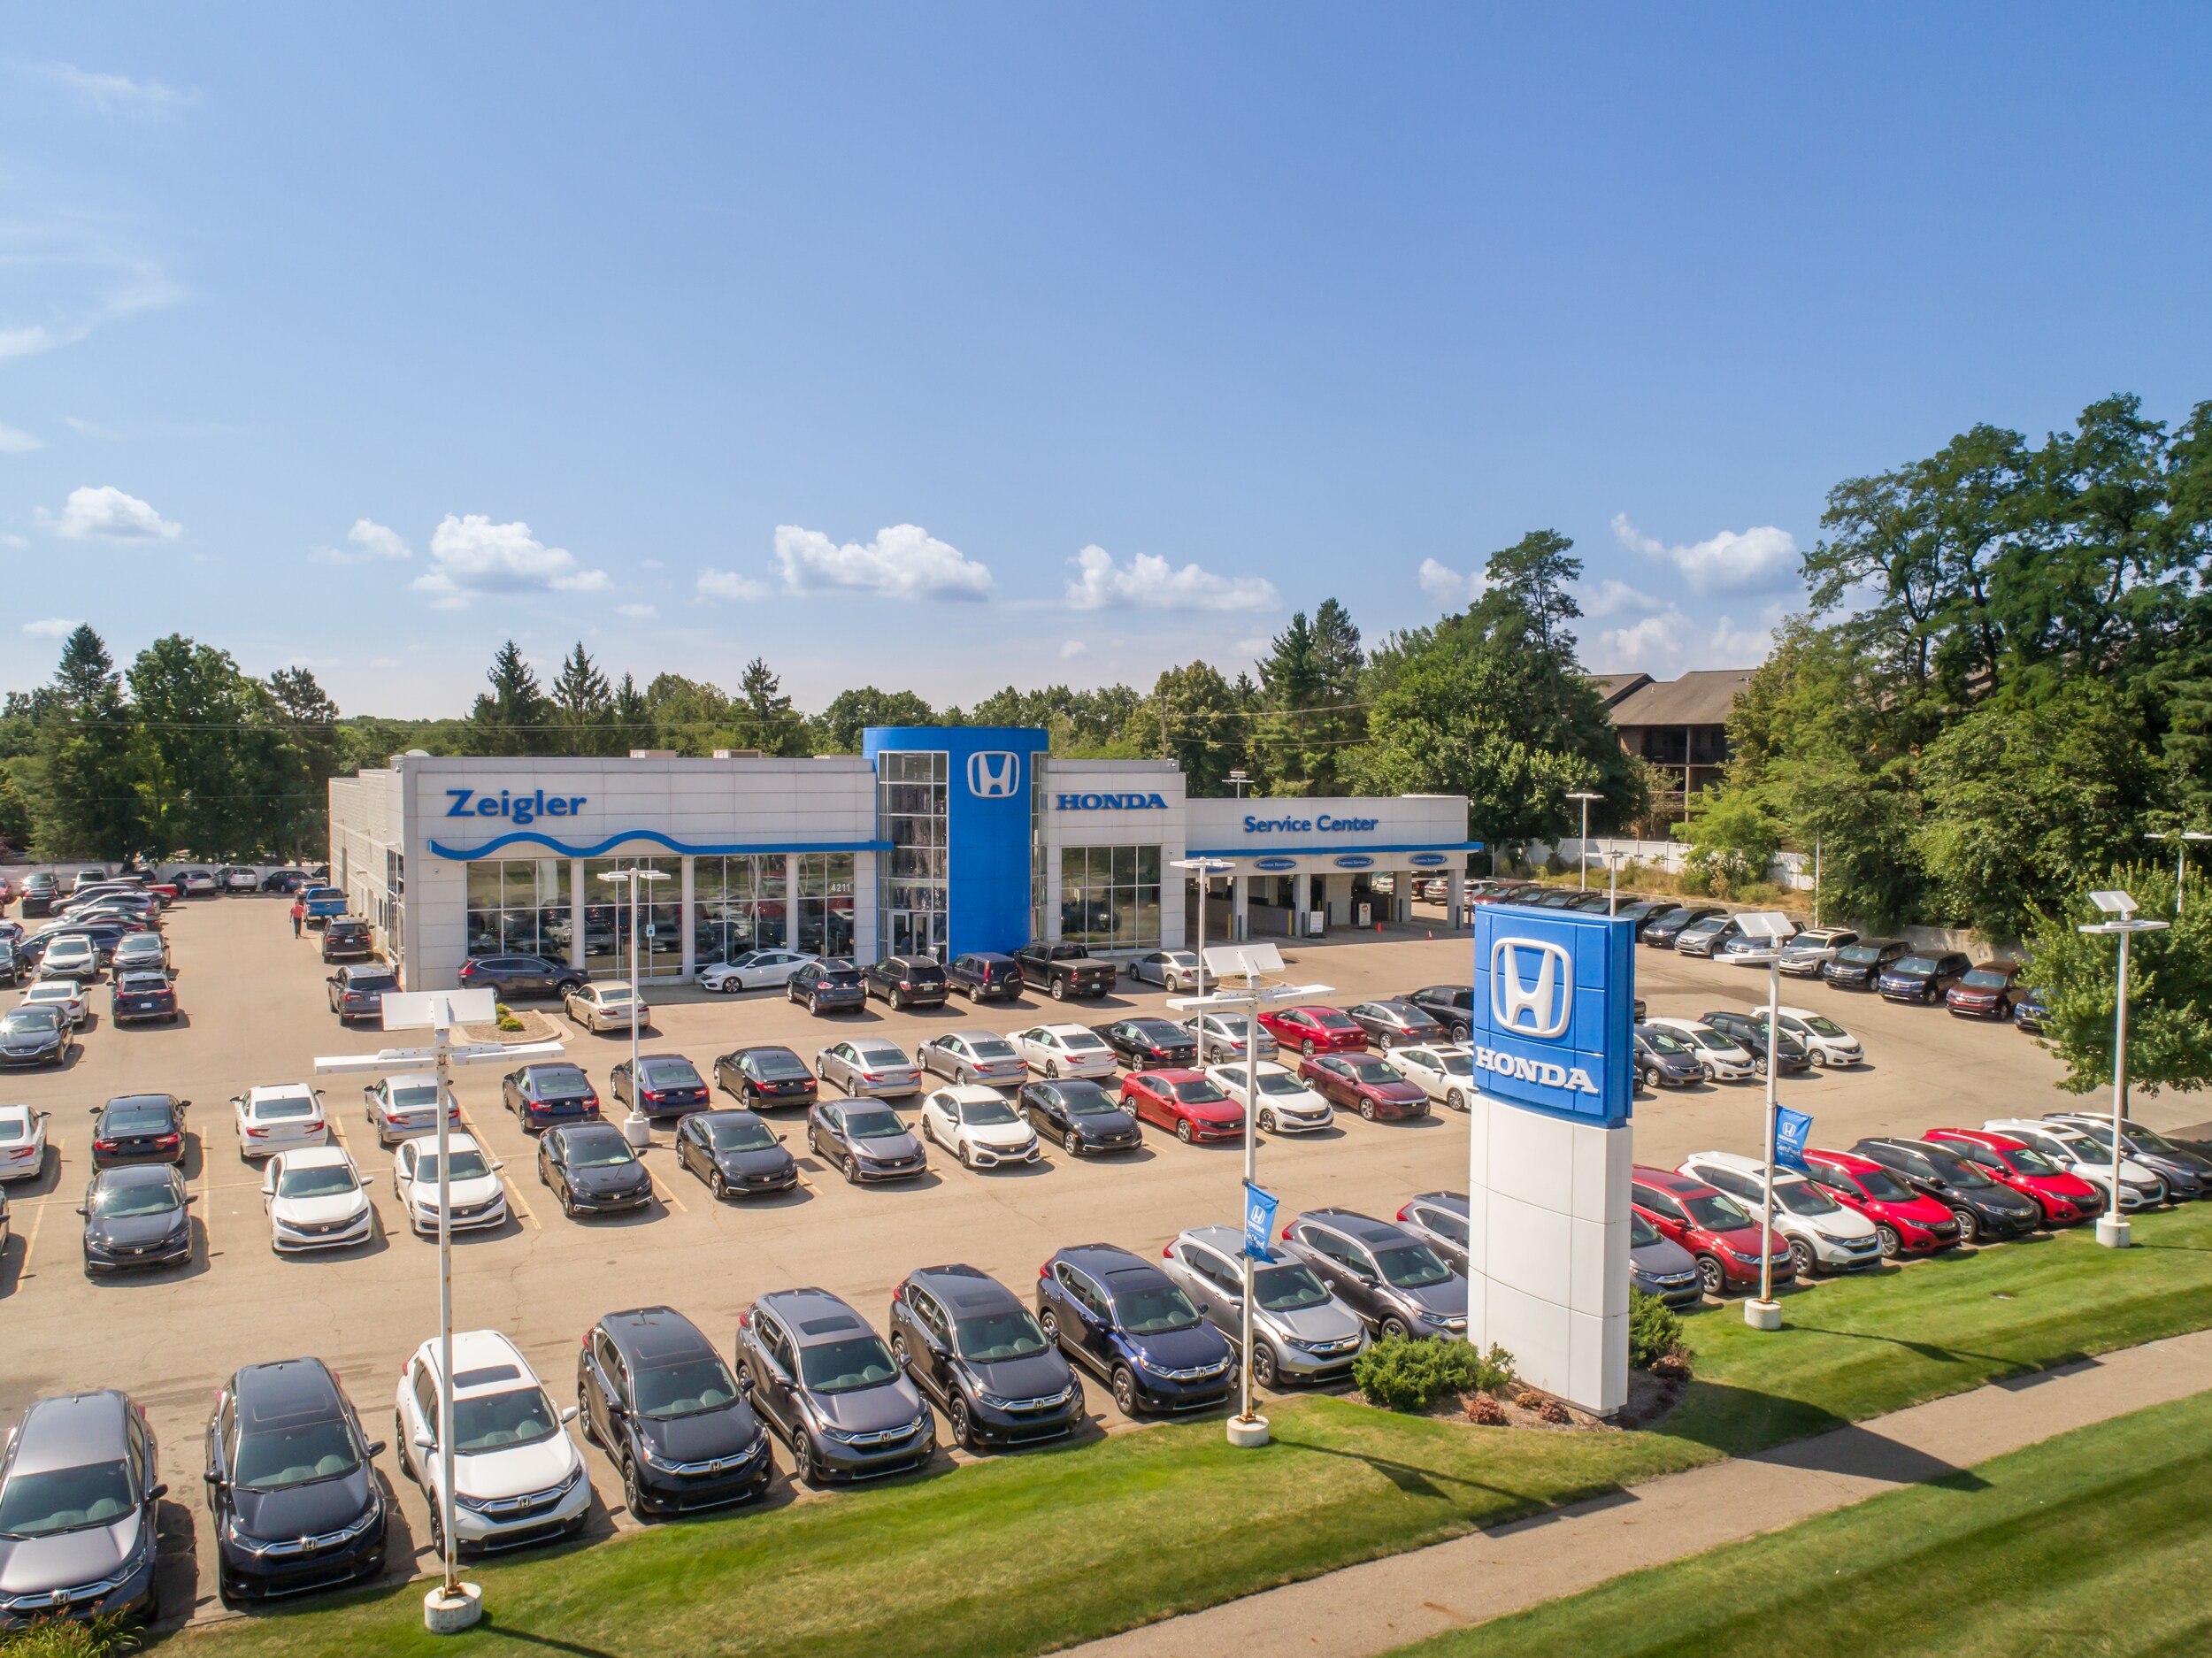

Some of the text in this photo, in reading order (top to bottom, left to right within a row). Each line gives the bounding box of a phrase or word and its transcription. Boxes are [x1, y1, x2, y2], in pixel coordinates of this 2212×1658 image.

[446, 789, 588, 825] Zeigler
[1056, 793, 1168, 810] HONDA
[1244, 814, 1379, 833] Service Center
[831, 883, 850, 892] 4211
[1475, 1046, 1600, 1094] HONDA
